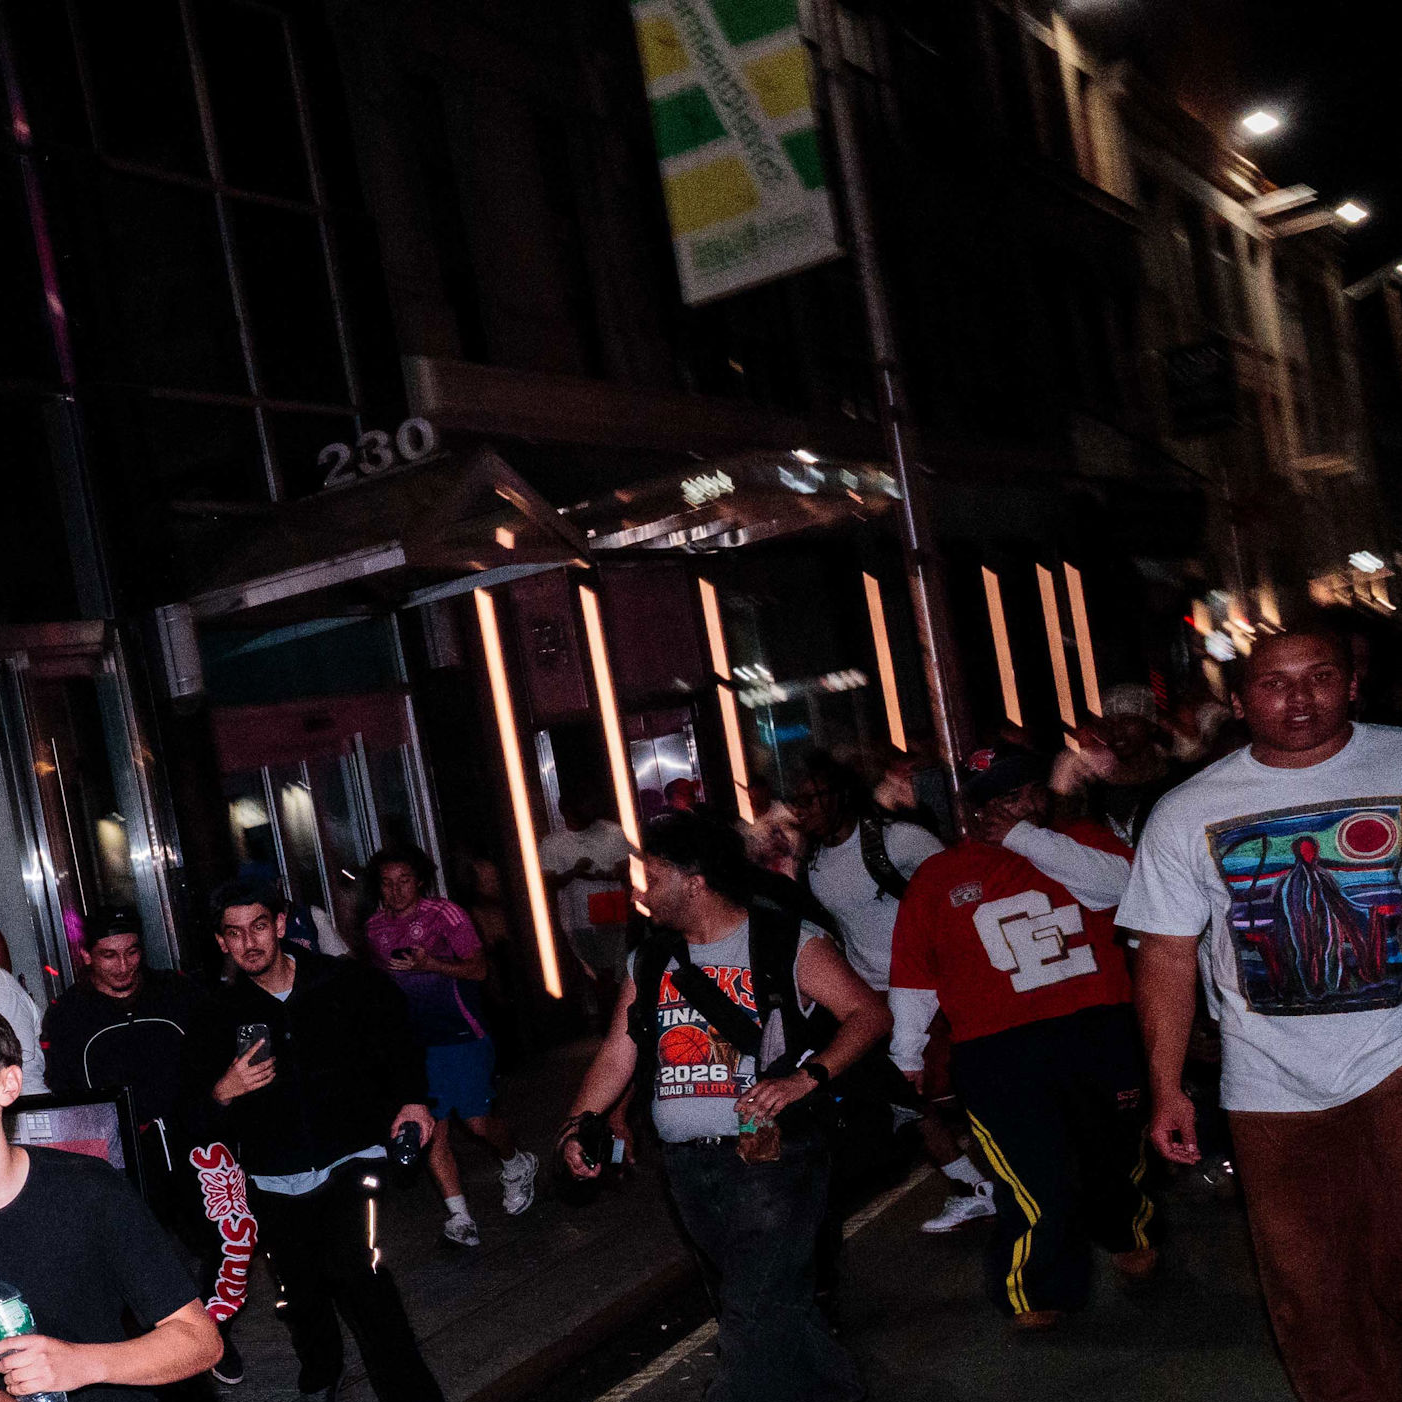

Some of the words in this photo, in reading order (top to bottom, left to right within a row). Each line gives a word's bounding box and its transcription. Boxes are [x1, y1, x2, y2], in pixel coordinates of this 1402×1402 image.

[317, 416, 435, 487] 230
[660, 1063, 729, 1083] 2026
[659, 1083, 683, 1097] ROAD
[695, 1082, 736, 1095] GLORY
